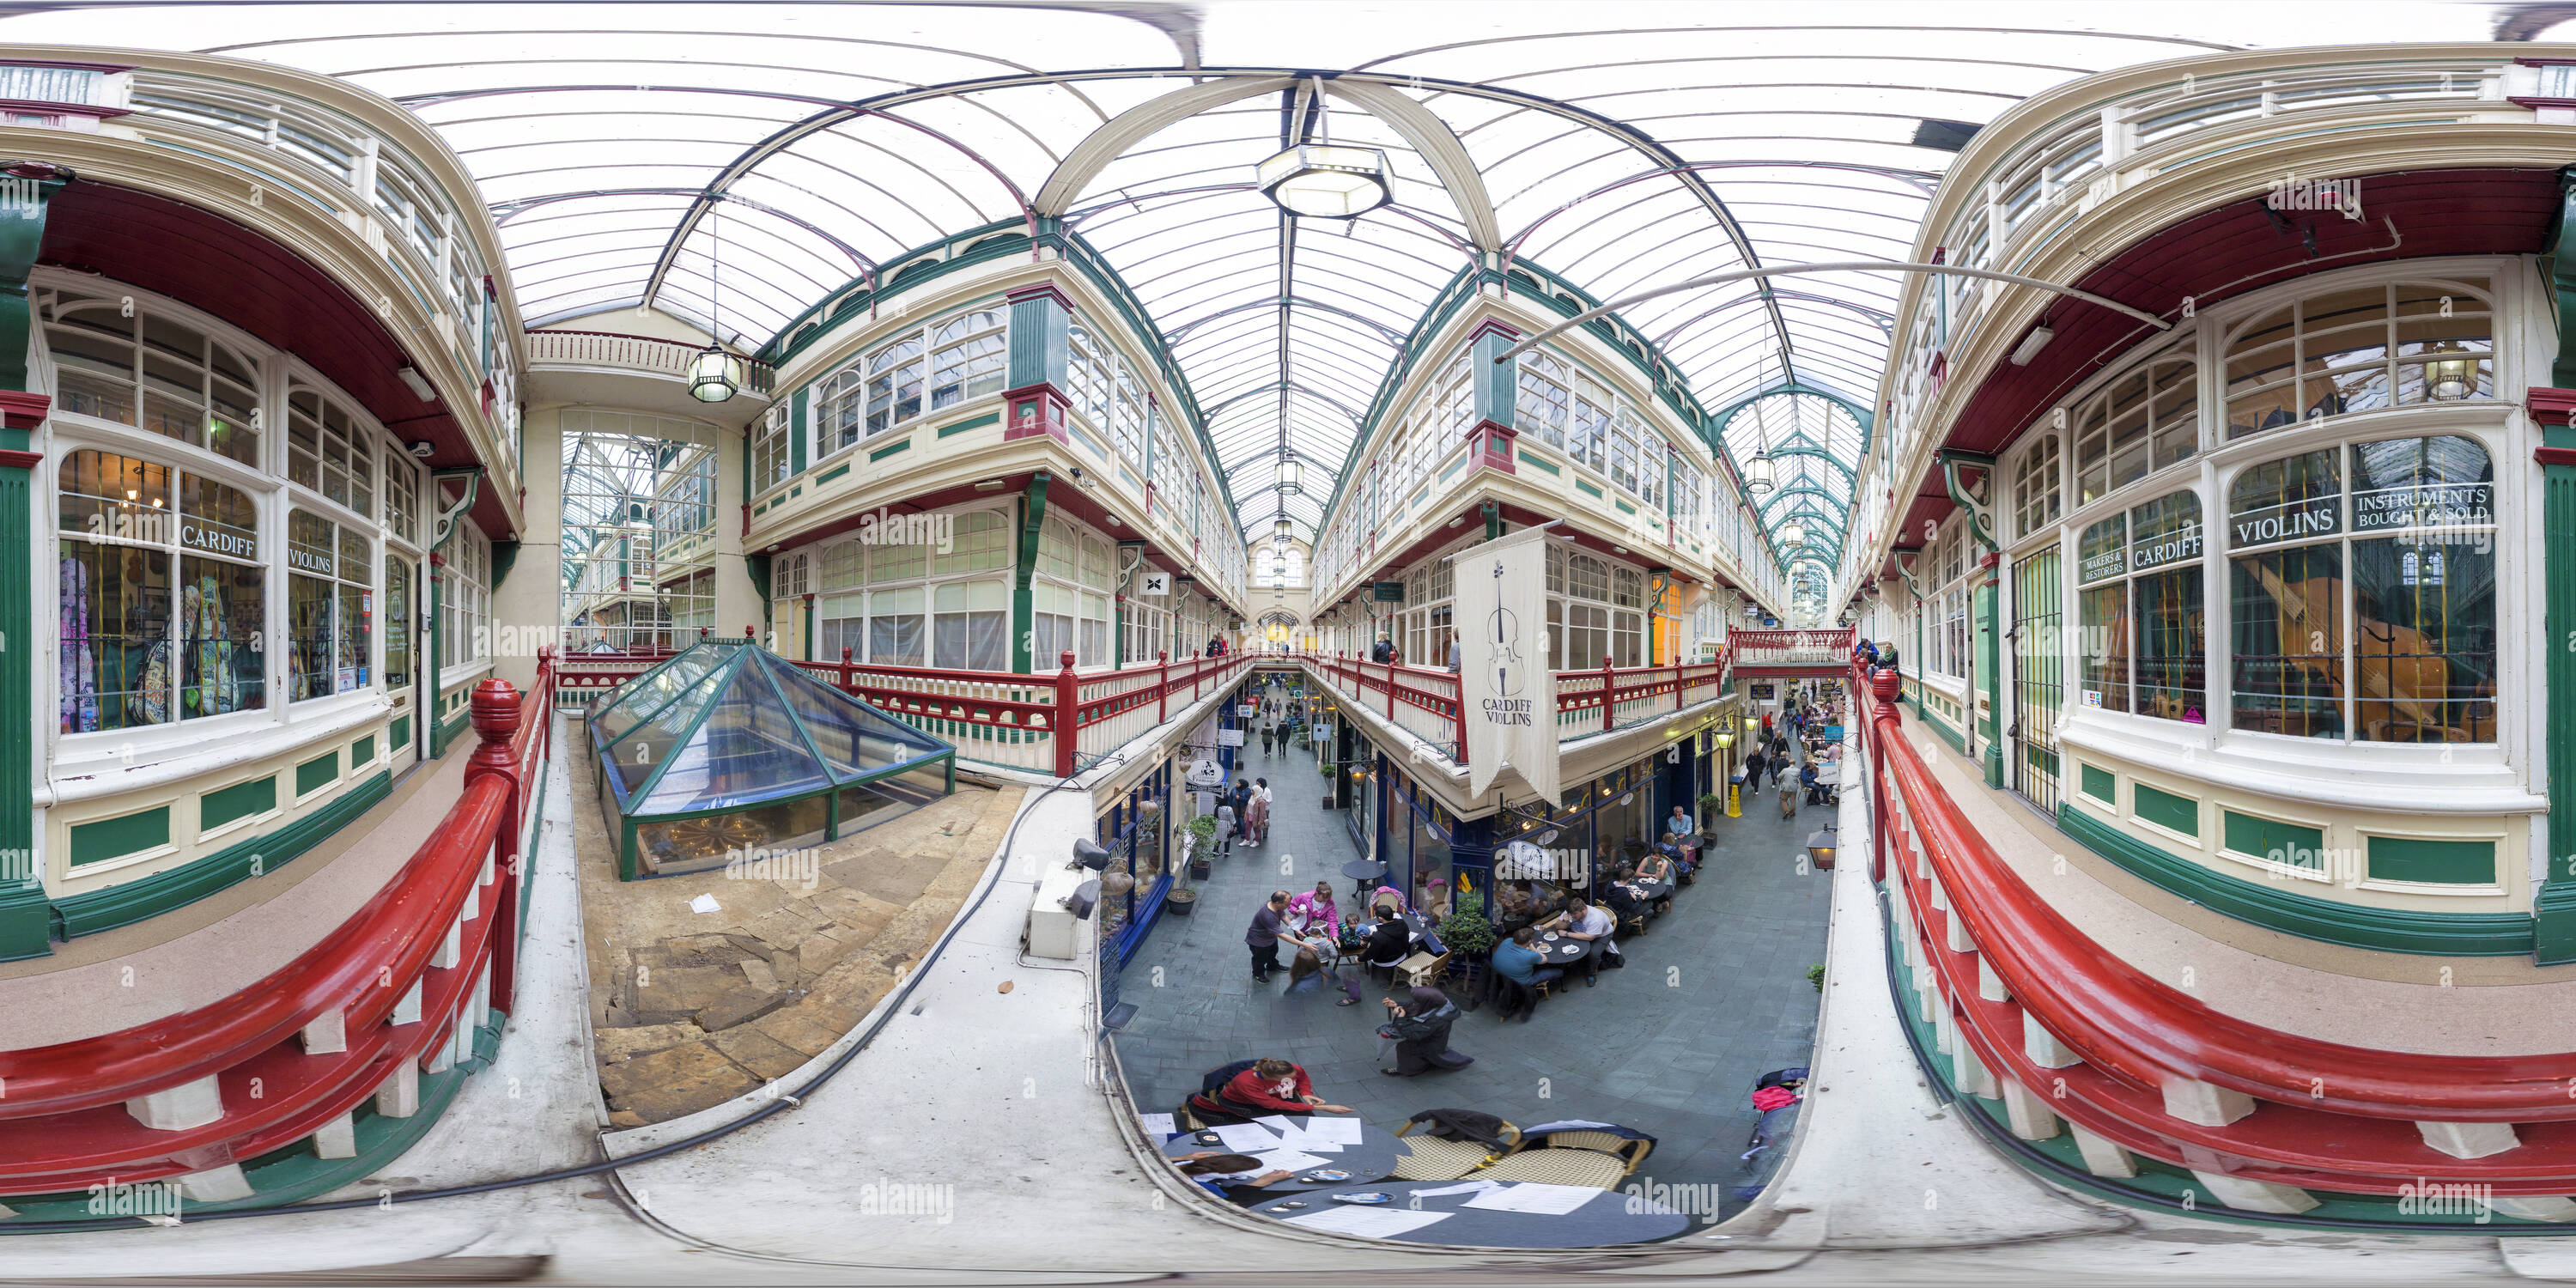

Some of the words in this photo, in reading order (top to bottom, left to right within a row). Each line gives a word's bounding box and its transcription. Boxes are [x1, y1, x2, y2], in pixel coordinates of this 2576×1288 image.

[2358, 489, 2488, 511] INSTRUMENTS
[2237, 508, 2334, 543] VIOLINS
[2359, 508, 2425, 526] BOUGHT
[2428, 508, 2441, 520] &
[2445, 507, 2488, 519] SOLD
[182, 526, 254, 556] CARDIFF
[2135, 535, 2202, 567] CARDIFF
[289, 549, 331, 573] VIOLINS
[2087, 554, 2114, 570] MAKERS
[2115, 551, 2122, 562] &
[2086, 562, 2123, 581] RESTORERS
[1483, 698, 1532, 712] CARDIFF
[1485, 712, 1532, 727] VIOLINS
